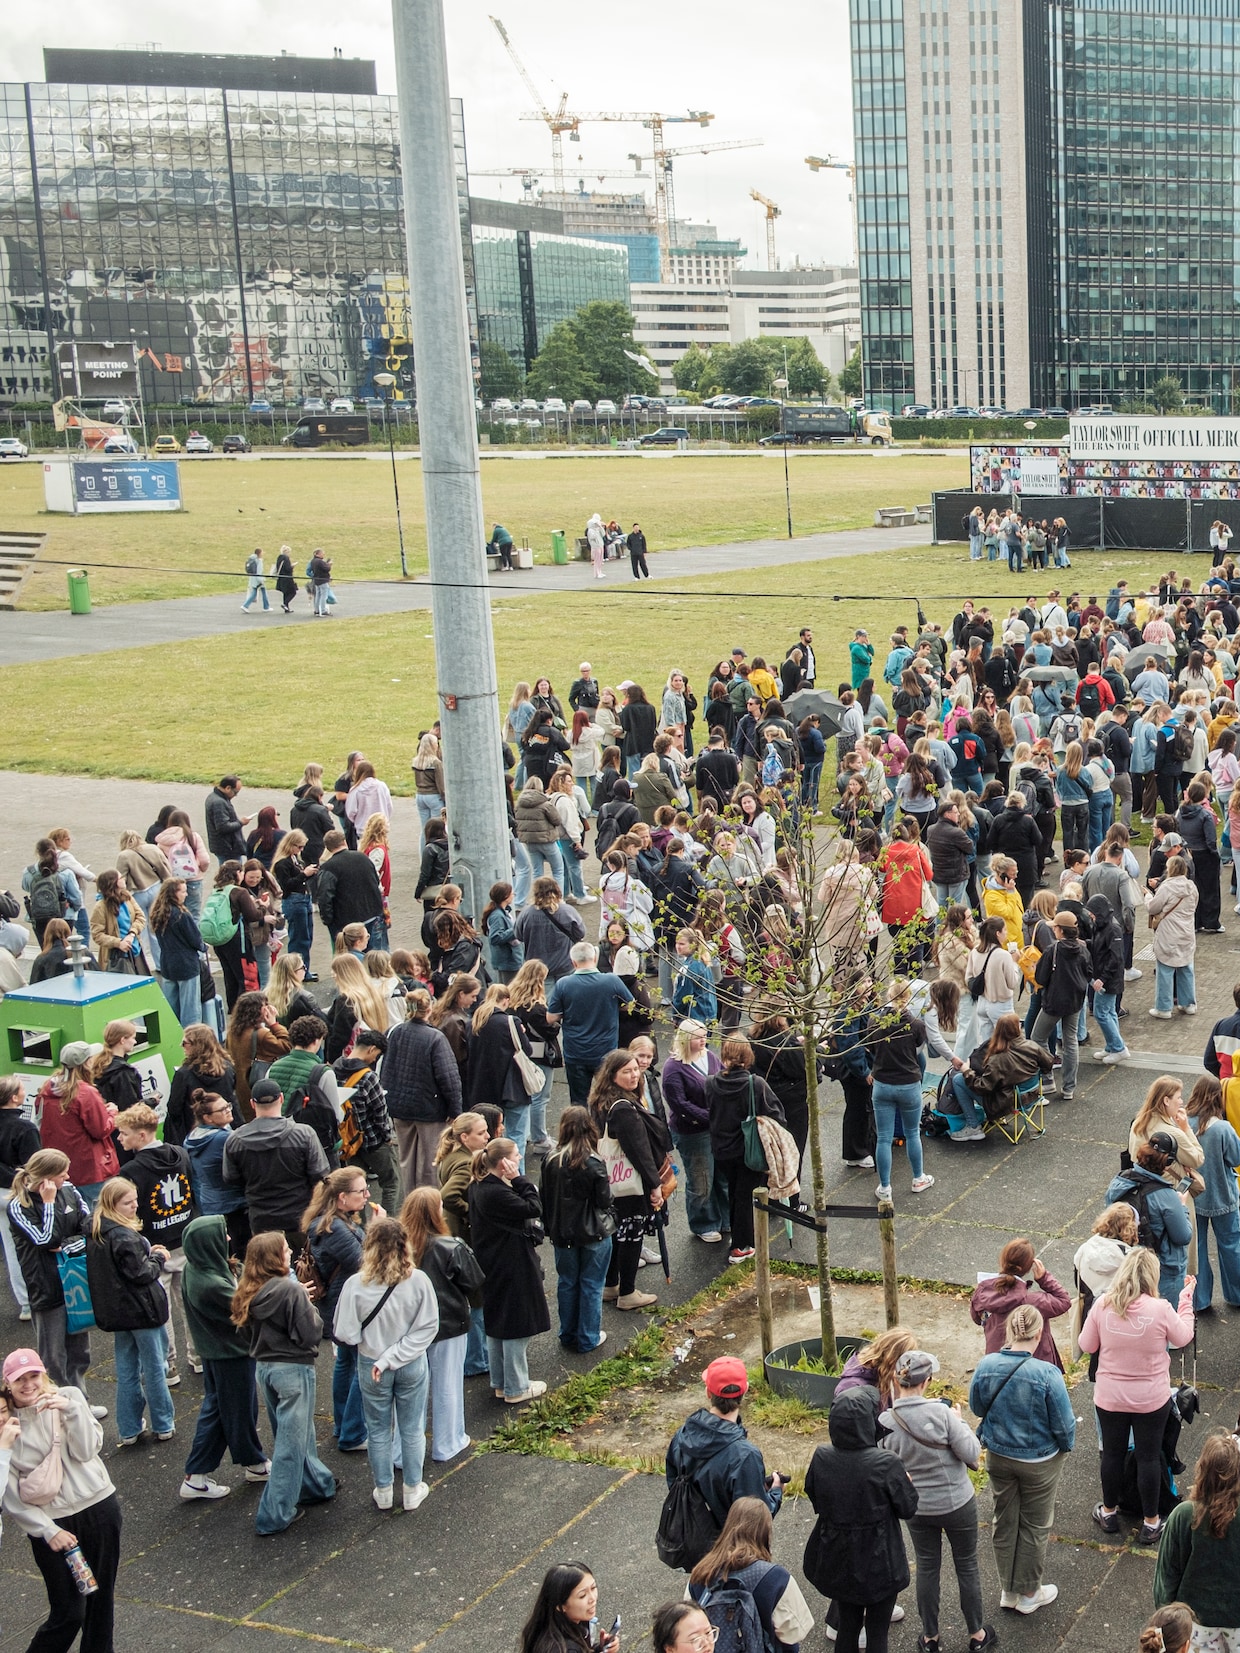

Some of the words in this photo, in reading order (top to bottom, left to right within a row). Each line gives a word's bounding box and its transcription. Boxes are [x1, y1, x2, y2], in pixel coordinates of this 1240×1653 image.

[84, 361, 129, 369] MEETING
[93, 371, 123, 379] POINT
[1072, 425, 1108, 441] TAYLOR
[1110, 425, 1140, 442] SWIFT
[1143, 430, 1204, 447] OFFICIAL
[1073, 442, 1091, 450] THE
[1092, 442, 1114, 450] ERAS
[1116, 442, 1140, 451] TOUR
[1022, 474, 1041, 483] TAYLOR
[1041, 474, 1057, 484] SWIFT
[607, 1160, 634, 1185] ello
[152, 1221, 167, 1230] THE
